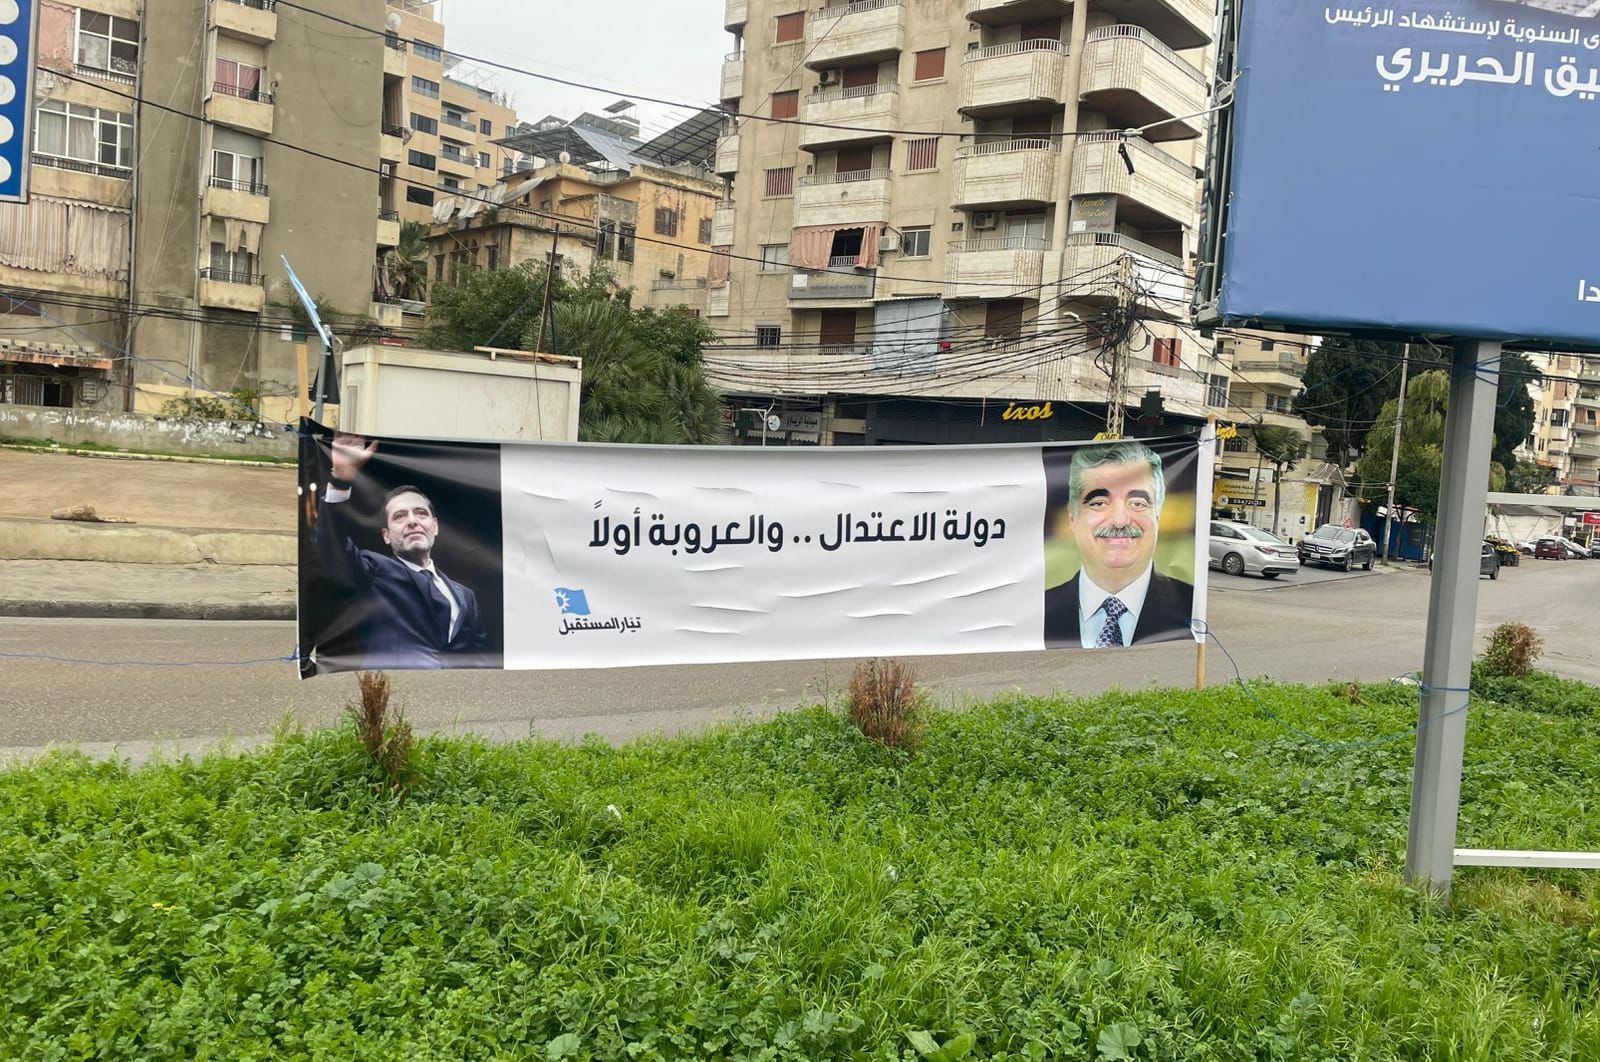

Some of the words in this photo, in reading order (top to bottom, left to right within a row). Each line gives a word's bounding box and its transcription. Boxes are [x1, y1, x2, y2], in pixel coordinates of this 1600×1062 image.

[1325, 6, 1394, 29] الرئيس
[1398, 11, 1500, 41] لإستشهاد
[1503, 19, 1580, 46] السنوية
[1375, 47, 1536, 92] الحريري
[1544, 55, 1600, 100] يق
[1002, 401, 1054, 420] ixos
[648, 513, 784, 556] والعروبة
[819, 510, 936, 552] الاعتدال
[943, 510, 1006, 548] دولة
